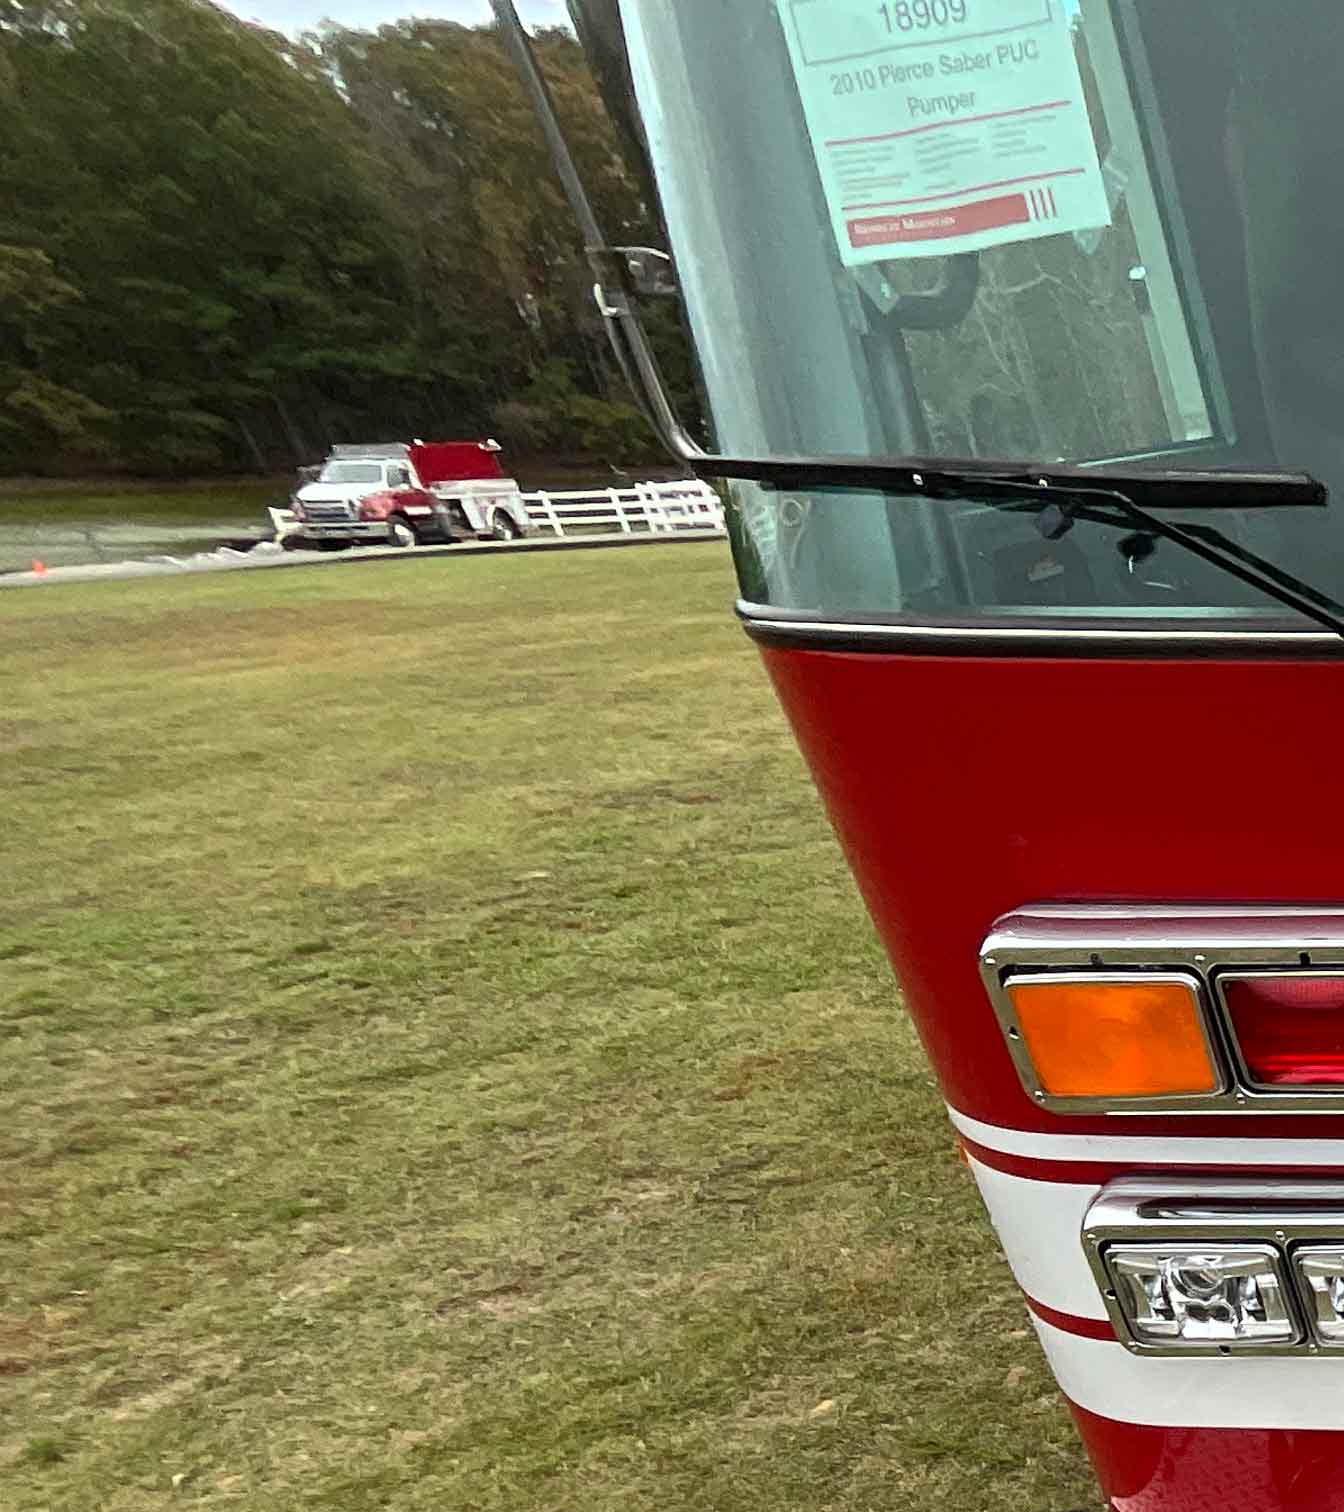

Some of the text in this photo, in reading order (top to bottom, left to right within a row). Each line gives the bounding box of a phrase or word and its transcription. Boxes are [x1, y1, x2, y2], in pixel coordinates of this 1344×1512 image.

[879, 0, 966, 33] 18909
[830, 39, 1040, 95] 2010 Pierce Saber PUC
[907, 91, 976, 117] Pumper
